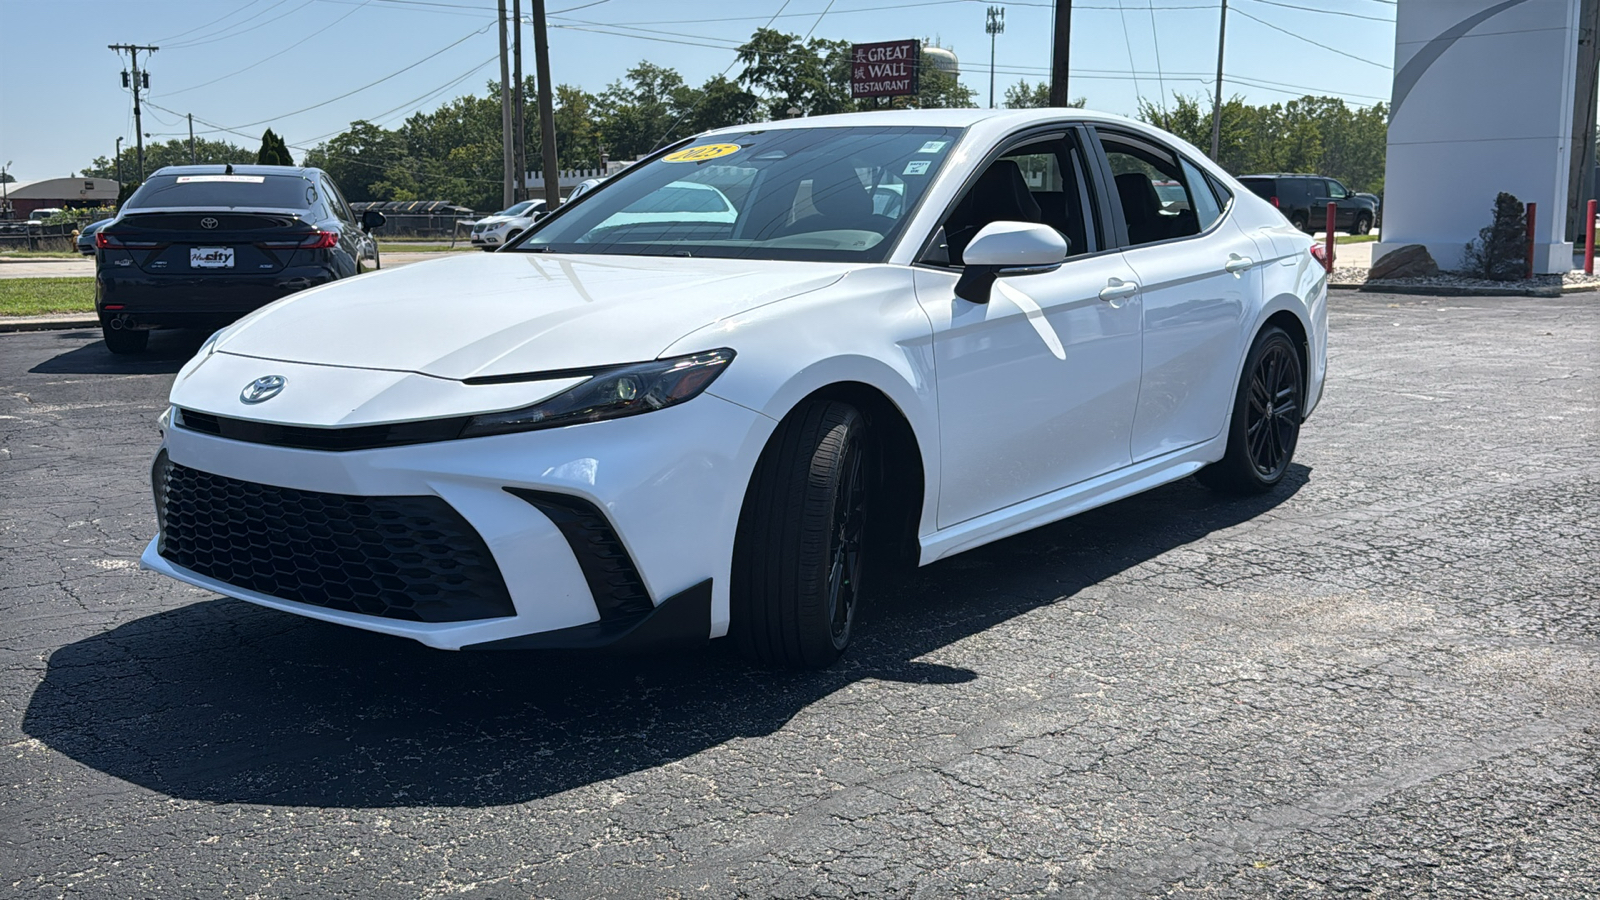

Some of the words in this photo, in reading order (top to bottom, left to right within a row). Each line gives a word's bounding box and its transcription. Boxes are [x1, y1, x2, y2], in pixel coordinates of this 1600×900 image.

[868, 45, 910, 62] GREAT
[868, 62, 907, 78] WALL
[854, 80, 910, 93] RESTAURANT
[669, 145, 732, 160] 2025
